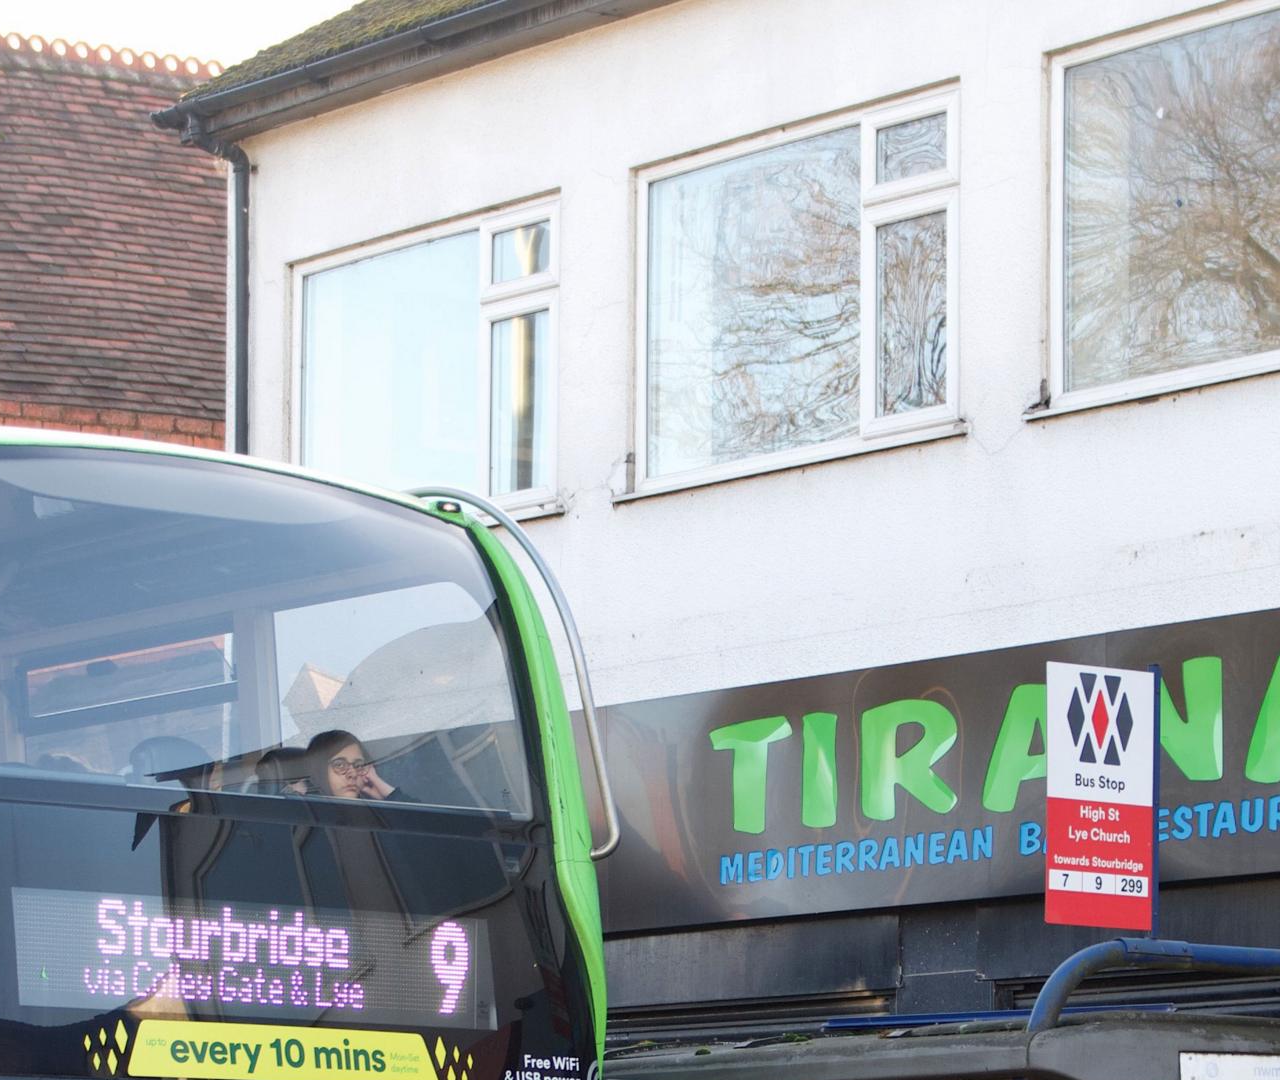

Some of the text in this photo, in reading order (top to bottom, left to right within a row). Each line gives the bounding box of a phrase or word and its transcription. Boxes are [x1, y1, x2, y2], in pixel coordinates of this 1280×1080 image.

[1074, 773, 1126, 792] Bus Stop
[1079, 805, 1120, 823] High St
[1068, 825, 1131, 844] Lye Church
[719, 825, 994, 886] MEDITERRANEAN
[1053, 853, 1144, 873] towards Stourbridge
[1061, 873, 1143, 893] 7 9 299
[97, 899, 350, 969] Stourbridge
[430, 921, 470, 1015] 9
[84, 960, 365, 1009] via Colley Gate & Lye
[170, 1039, 262, 1074] every
[270, 1038, 305, 1068] 10
[314, 1038, 387, 1073] mins
[524, 1054, 580, 1071] Free WiFi
